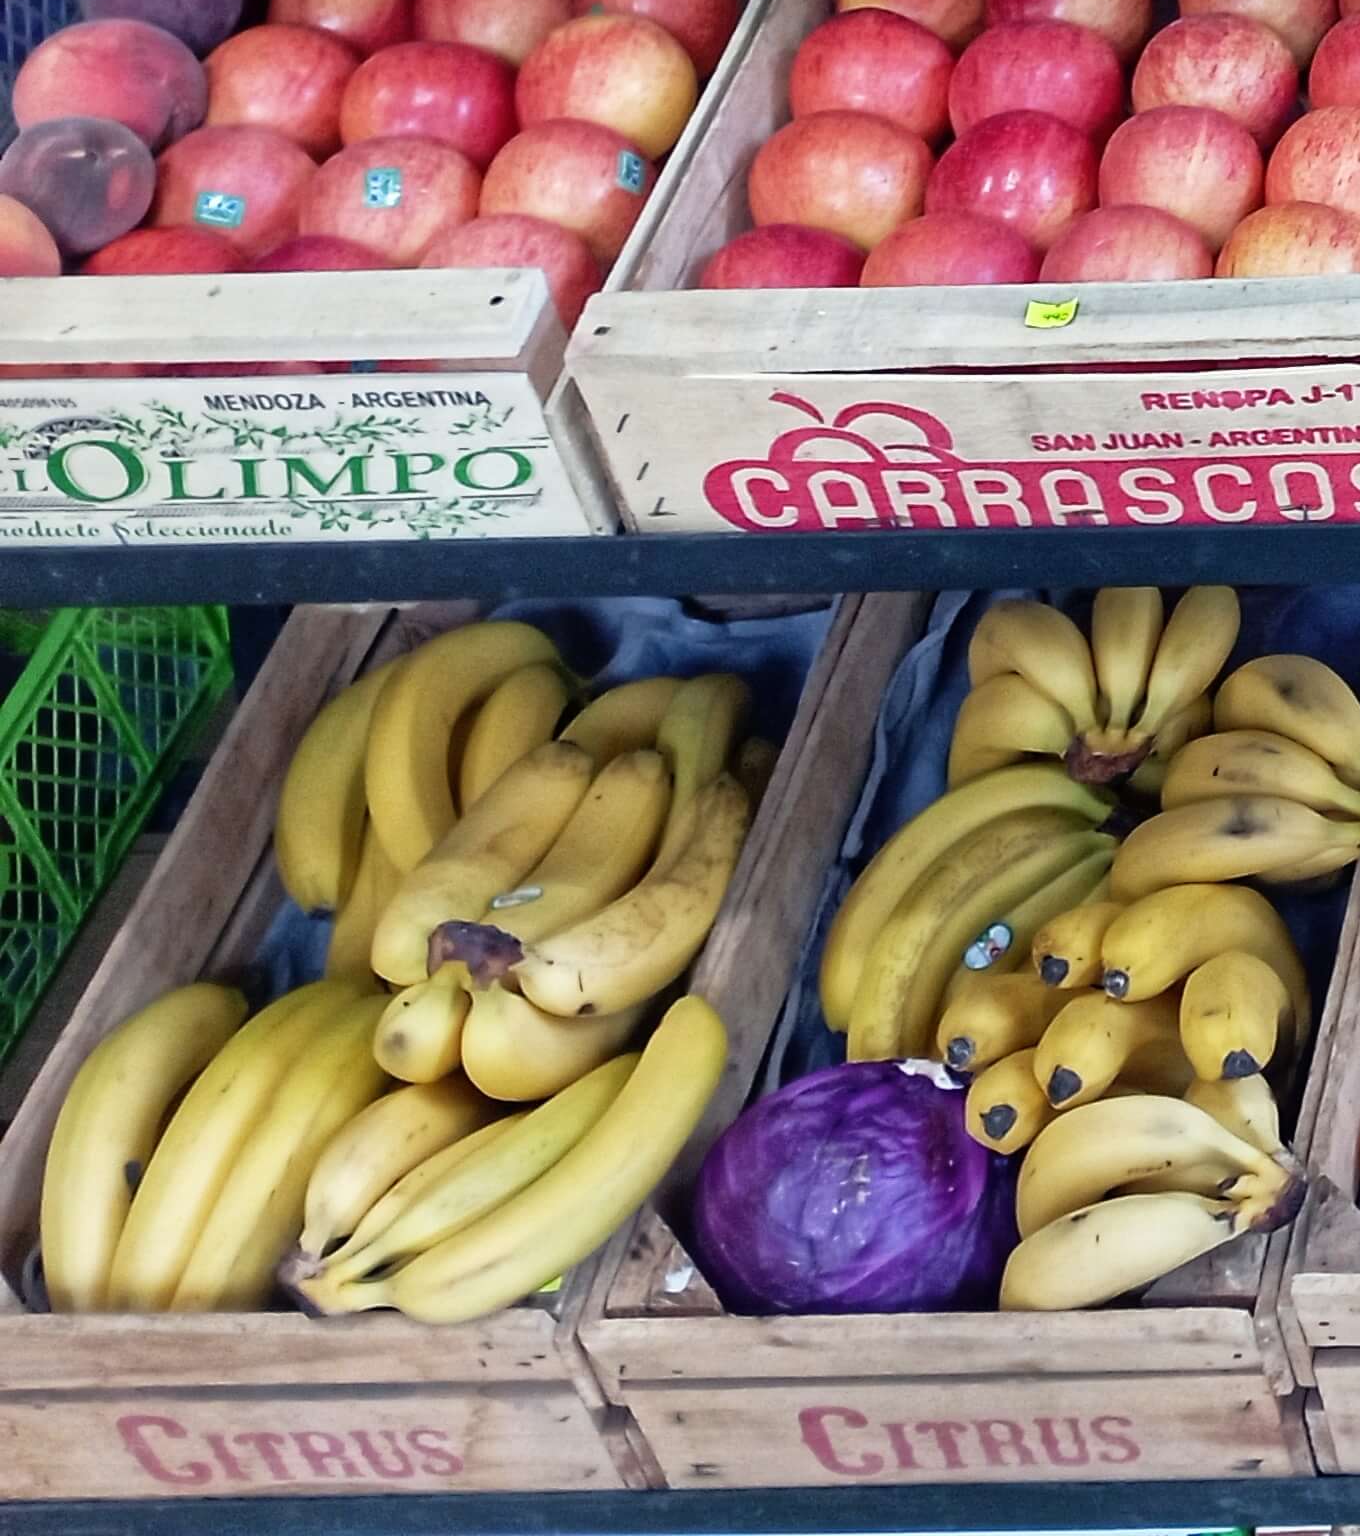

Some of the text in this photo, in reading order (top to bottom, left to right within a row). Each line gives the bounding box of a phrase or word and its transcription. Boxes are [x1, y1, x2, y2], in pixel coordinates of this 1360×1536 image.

[204, 392, 327, 412] MENDOZA
[1142, 385, 1294, 411] RENSPA
[1031, 430, 1097, 452] SAN
[1102, 429, 1185, 451] JUAN
[46, 439, 533, 504] OLIMPO
[0, 519, 293, 545] roducto Seleccionado
[116, 1413, 466, 1486] CITRUS
[800, 1404, 1143, 1477] CITRUS
